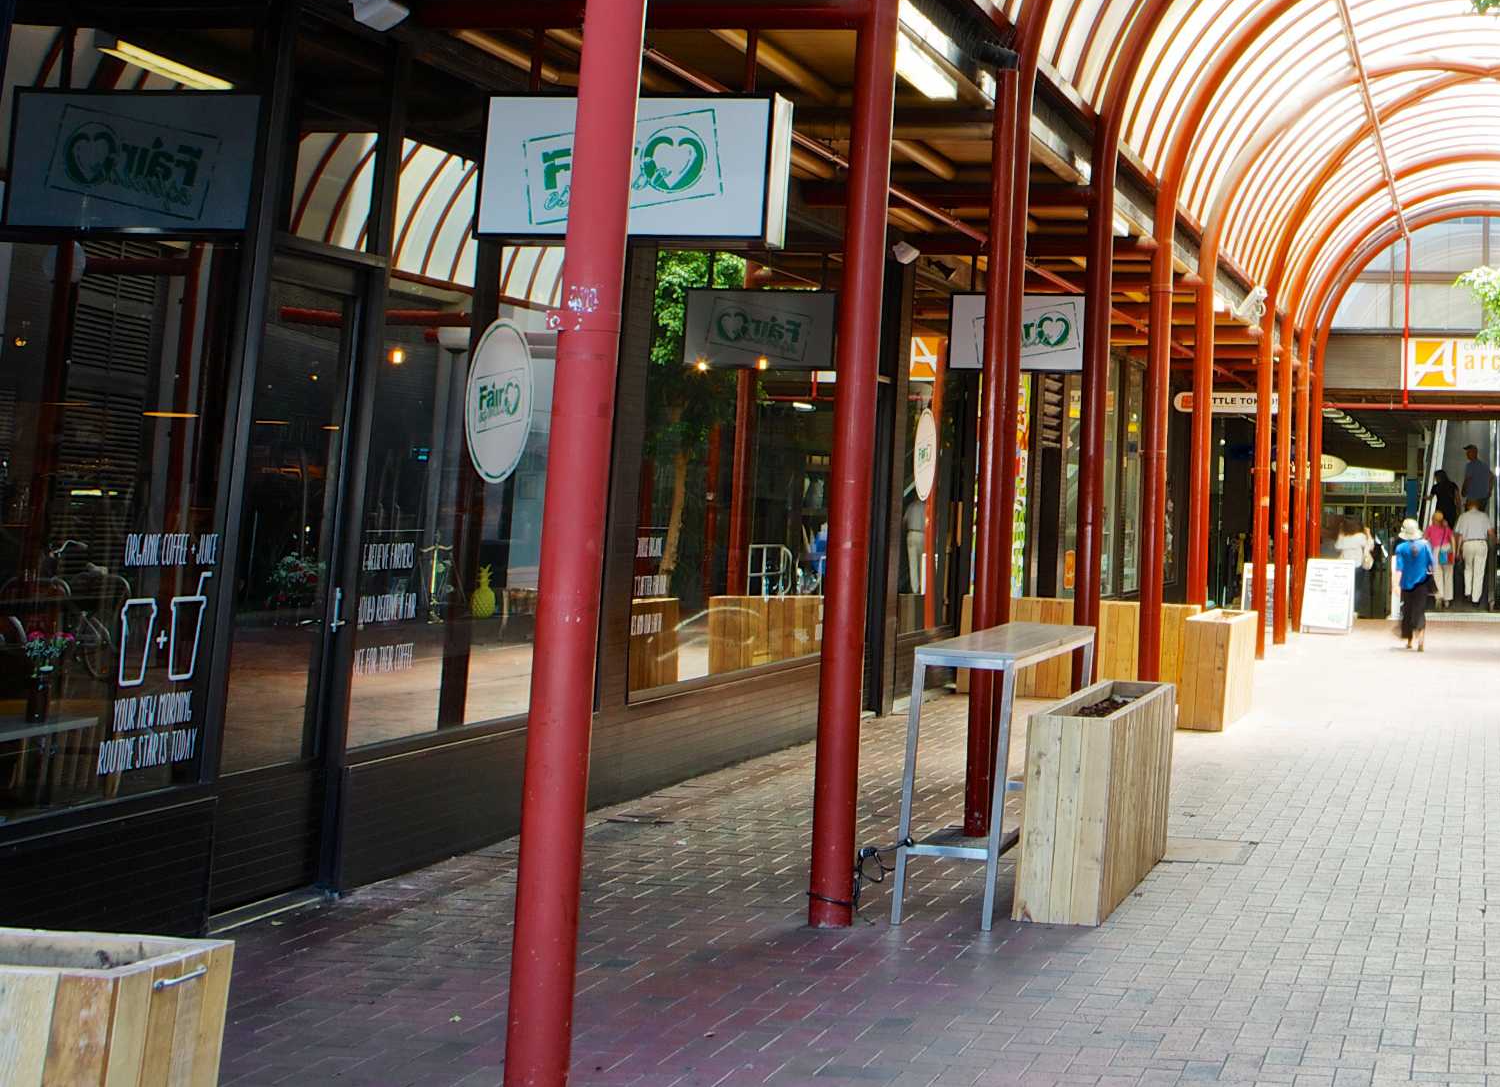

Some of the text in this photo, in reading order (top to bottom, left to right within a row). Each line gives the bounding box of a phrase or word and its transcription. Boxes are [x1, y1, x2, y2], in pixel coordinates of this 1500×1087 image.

[1212, 397, 1237, 405] TTLE
[125, 533, 161, 567] ORGANIC
[161, 533, 190, 565] COFFEE
[196, 533, 218, 565] JUICE
[390, 542, 414, 569] FARMERS
[365, 647, 377, 674] FOR
[379, 645, 394, 674] THEIR
[394, 643, 413, 671] COFFEE
[113, 690, 193, 732] YOUR NEW MORNING
[97, 728, 198, 775] ROUTINE STARTS TODAY
